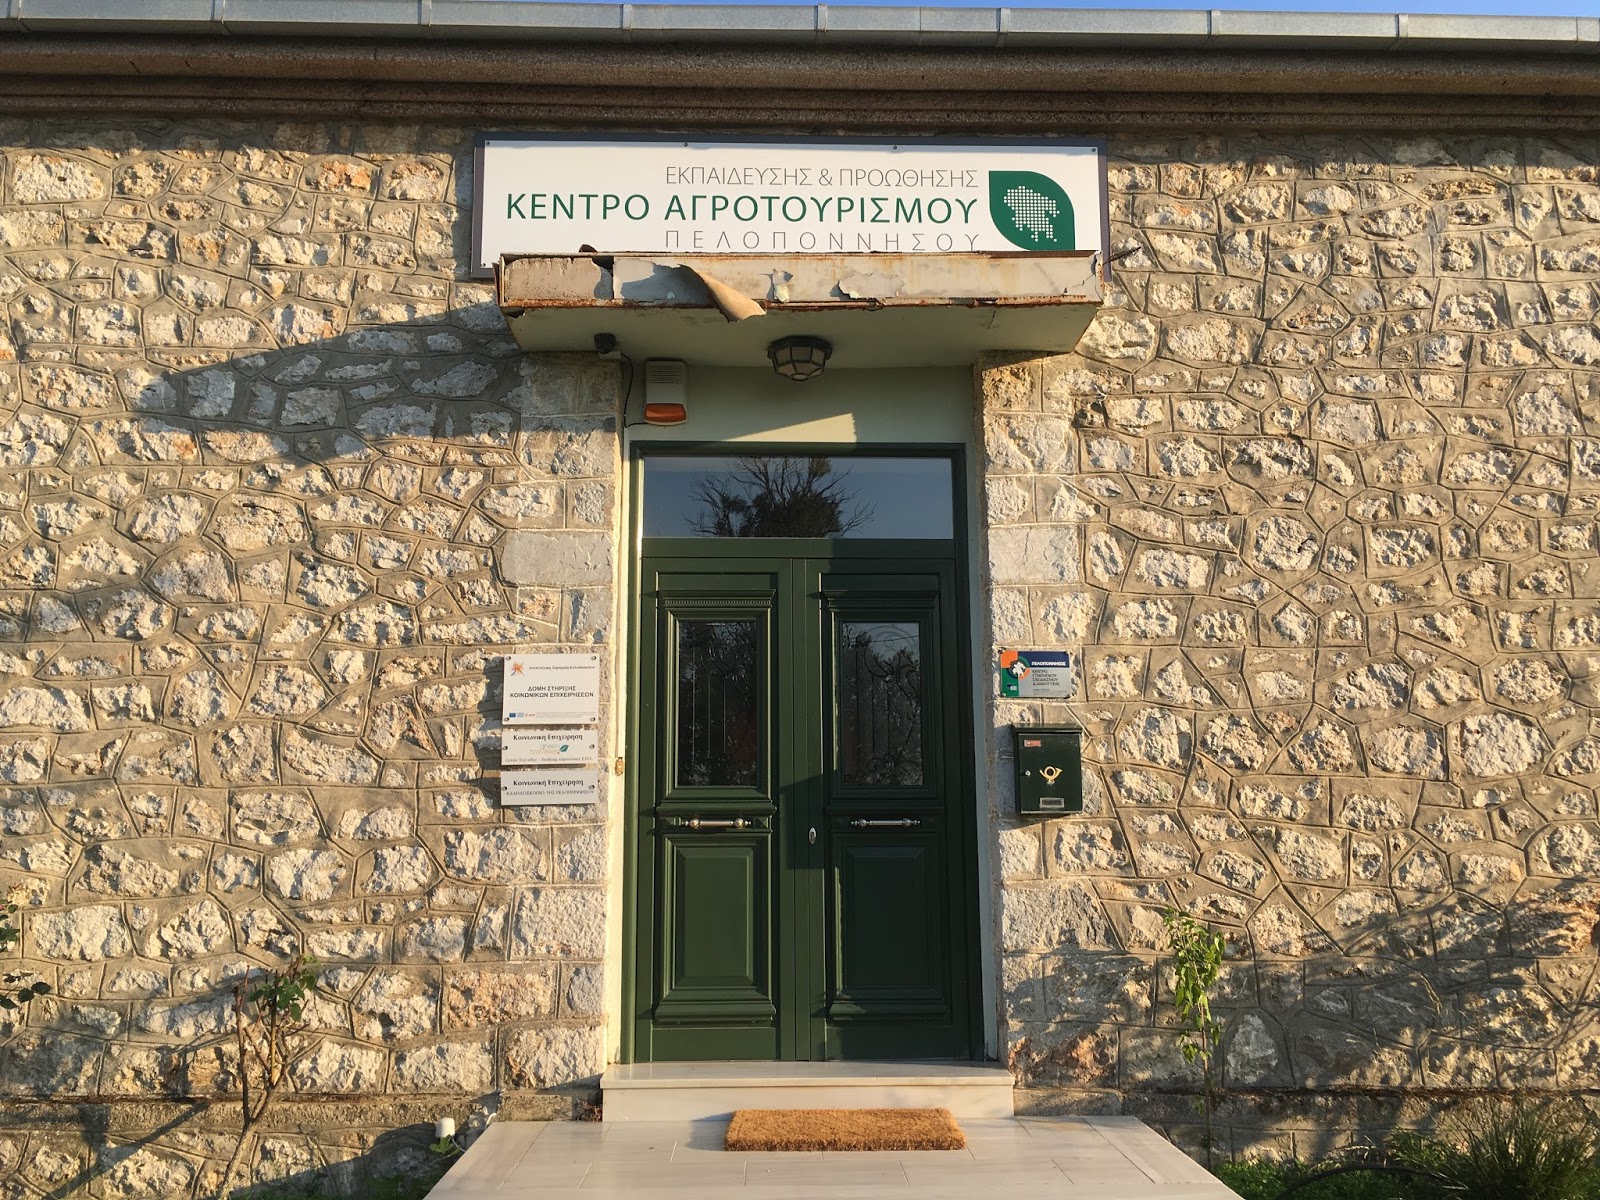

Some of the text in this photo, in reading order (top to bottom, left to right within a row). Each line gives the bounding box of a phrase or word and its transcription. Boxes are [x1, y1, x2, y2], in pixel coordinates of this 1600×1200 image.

[665, 166, 979, 188] ΕΚΠΑΙΔΕΥΣΗΣ & ΠΡΟΩΘΗΣΗΣ
[507, 193, 978, 225] ΚΕΝΤΡΟ ΑΓΡΟΤΟΥΡΙΣΜΟΥ
[665, 230, 980, 252] ΠΕΛΟΠΟΝΝΗΣΟΥ
